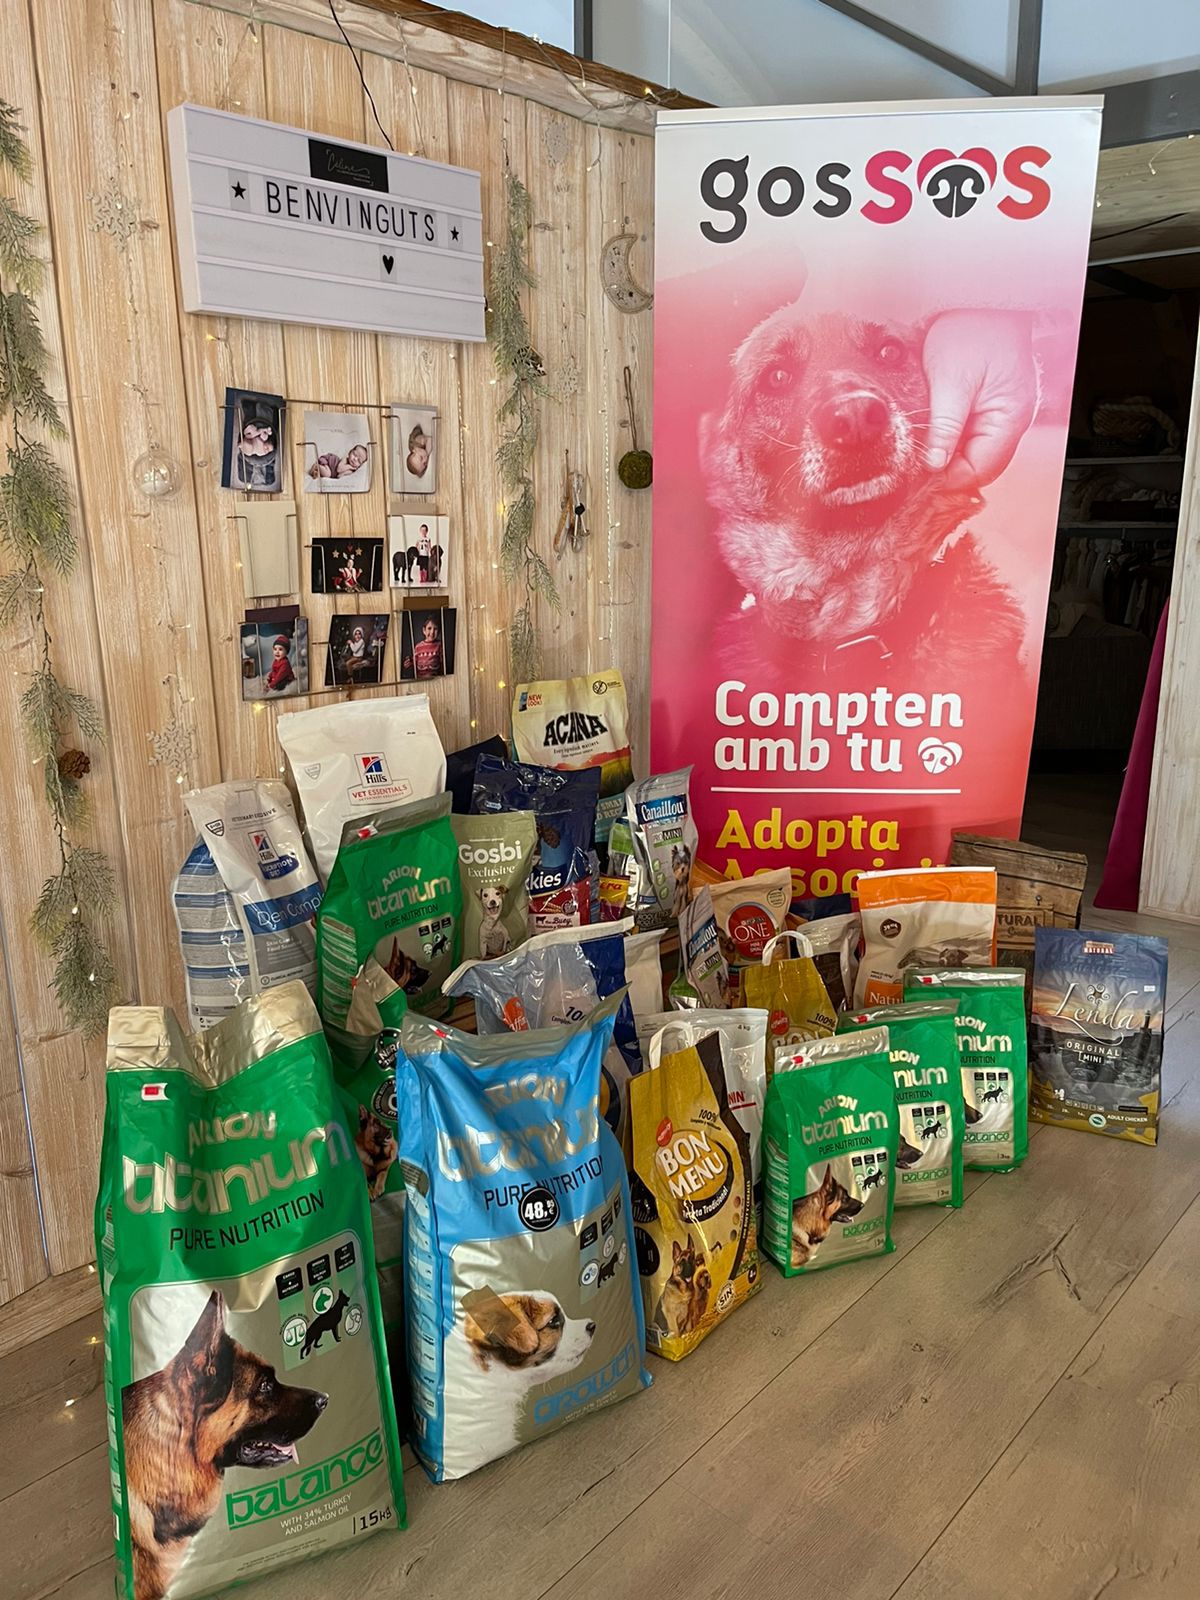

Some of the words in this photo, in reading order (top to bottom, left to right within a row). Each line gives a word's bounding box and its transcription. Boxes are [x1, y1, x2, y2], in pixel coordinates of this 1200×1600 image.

[266, 181, 435, 242] BENVINGUTS
[714, 680, 964, 735] Compten
[543, 711, 608, 747] ACANA
[714, 715, 831, 772] amb
[846, 733, 903, 772] tu
[352, 790, 367, 799] VET
[367, 784, 408, 796] ESSENTIALS
[641, 801, 684, 822] Canaillou
[663, 828, 682, 841] MINI
[715, 807, 899, 857] Adopta
[458, 840, 522, 864] Gosbi
[382, 865, 422, 892] ARION
[467, 866, 516, 877] Exclusive
[524, 871, 562, 890] kies
[997, 913, 1038, 926] TURAL
[734, 922, 770, 942] ONE
[869, 991, 903, 1006] Natu
[815, 1012, 837, 1028] 100%
[954, 1016, 987, 1033] RION
[1053, 983, 1139, 1047] Lenda
[958, 1035, 1012, 1052] nium
[1066, 1041, 1120, 1057] ORIGINAL
[889, 1050, 920, 1066] ION
[1082, 1054, 1102, 1063] MINI
[893, 1066, 948, 1088] nium
[818, 1094, 858, 1119] ARION
[802, 1110, 889, 1145] titanium
[659, 1130, 711, 1177] BON
[835, 1136, 873, 1151] NUTRITION
[484, 1182, 532, 1211] PURE
[536, 1156, 604, 1197] NUTRITIO
[668, 1152, 724, 1199] MENU
[169, 1227, 216, 1250] PURE
[219, 1189, 325, 1248] NUTRITION
[719, 1287, 733, 1307] SIN
[225, 1433, 383, 1527] balance
[280, 1512, 302, 1528] WITH
[304, 1508, 322, 1520] 34%
[323, 1494, 352, 1511] TURKEY
[285, 1525, 303, 1536] AND
[304, 1512, 337, 1529] SALMON
[338, 1505, 349, 1516] OIL
[359, 1506, 392, 1531] 15kg
